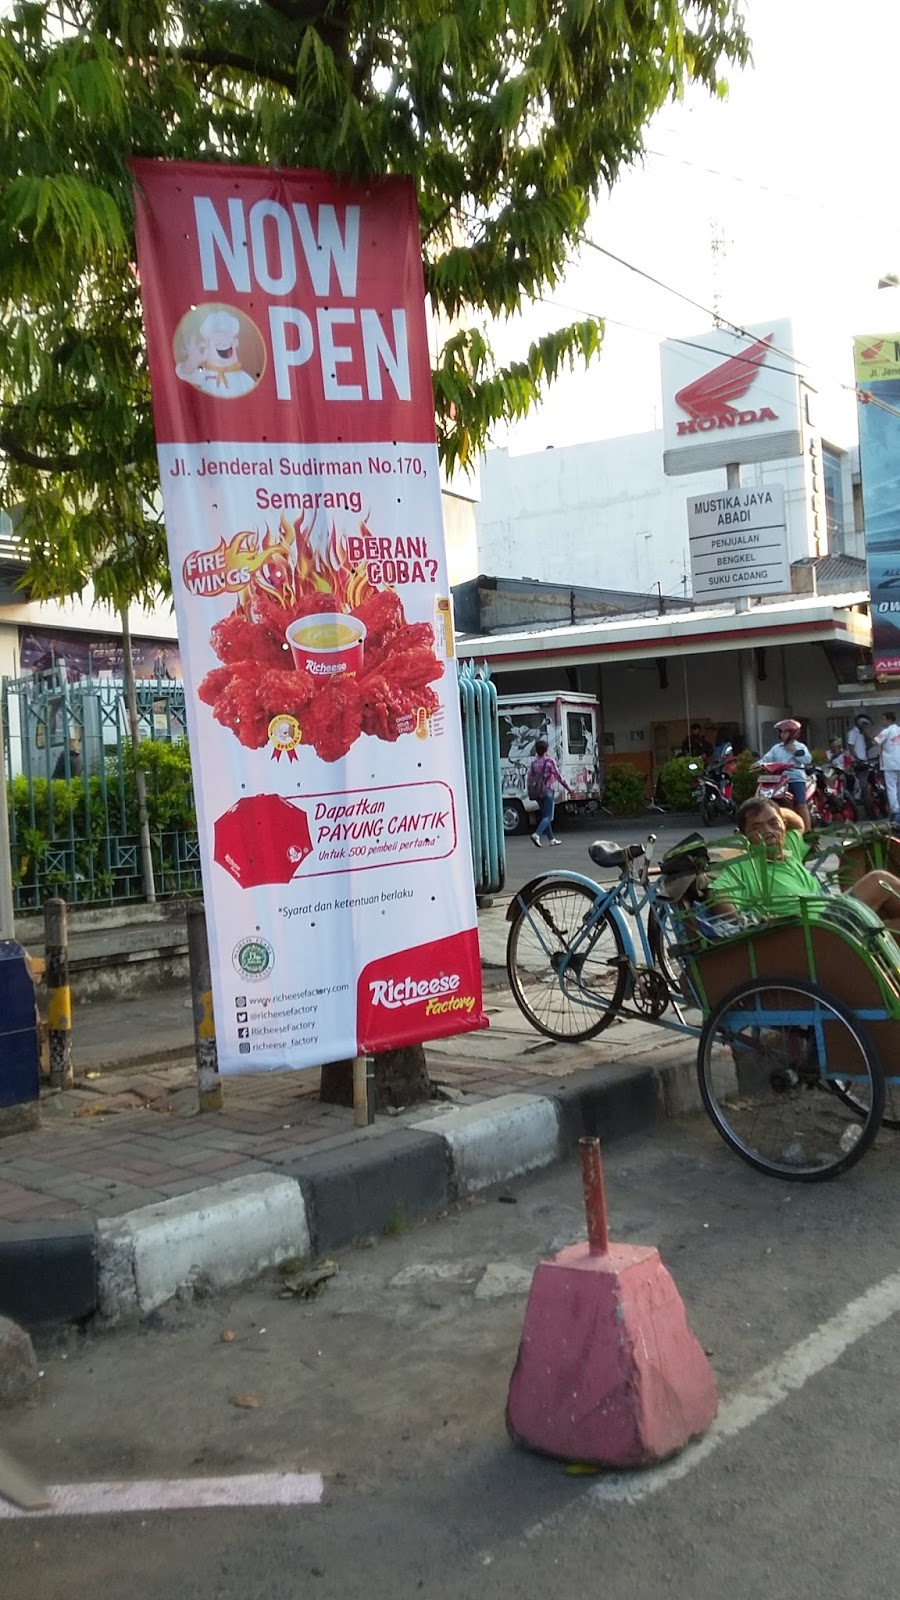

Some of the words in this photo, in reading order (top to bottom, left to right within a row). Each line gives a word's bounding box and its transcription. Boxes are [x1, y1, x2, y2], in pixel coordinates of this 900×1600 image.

[193, 197, 360, 298] NOW
[268, 306, 411, 401] PEN
[676, 407, 779, 436] HONDA
[170, 458, 191, 477] Jl.
[196, 458, 273, 477] Jenderal
[279, 457, 363, 476] Sudirman
[368, 457, 427, 478] No.170,
[256, 488, 362, 513] Semarang
[694, 496, 741, 515] MUSTIKA
[743, 492, 772, 507] JAYA
[717, 510, 751, 526] ABADI
[347, 536, 428, 560] BERANI
[711, 534, 760, 549] PENJUALAN
[186, 552, 226, 576] FIRE
[717, 553, 756, 566] BENGKEL
[188, 567, 251, 596] WINGS
[367, 560, 438, 584] COBA?
[708, 574, 730, 585] SUKU
[732, 570, 768, 582] CADANG
[305, 659, 347, 675] Richeese
[315, 798, 385, 823] Dapatkan
[317, 818, 384, 843] PAYUNG
[387, 811, 450, 835] CANTIK
[318, 848, 346, 861] Untuk
[348, 845, 367, 858] 500
[367, 841, 398, 857] pembeli
[314, 901, 332, 912] dan
[334, 895, 380, 910] ketentuan
[380, 888, 414, 902] berlaku
[249, 983, 350, 1006] www.richeesefactory.com
[369, 974, 461, 1009] Richeese
[250, 1004, 318, 1020] @richeesefactory
[425, 995, 476, 1016] Factory
[251, 1021, 316, 1036] RicheeseFactory
[252, 1035, 319, 1051] richeese_factory
